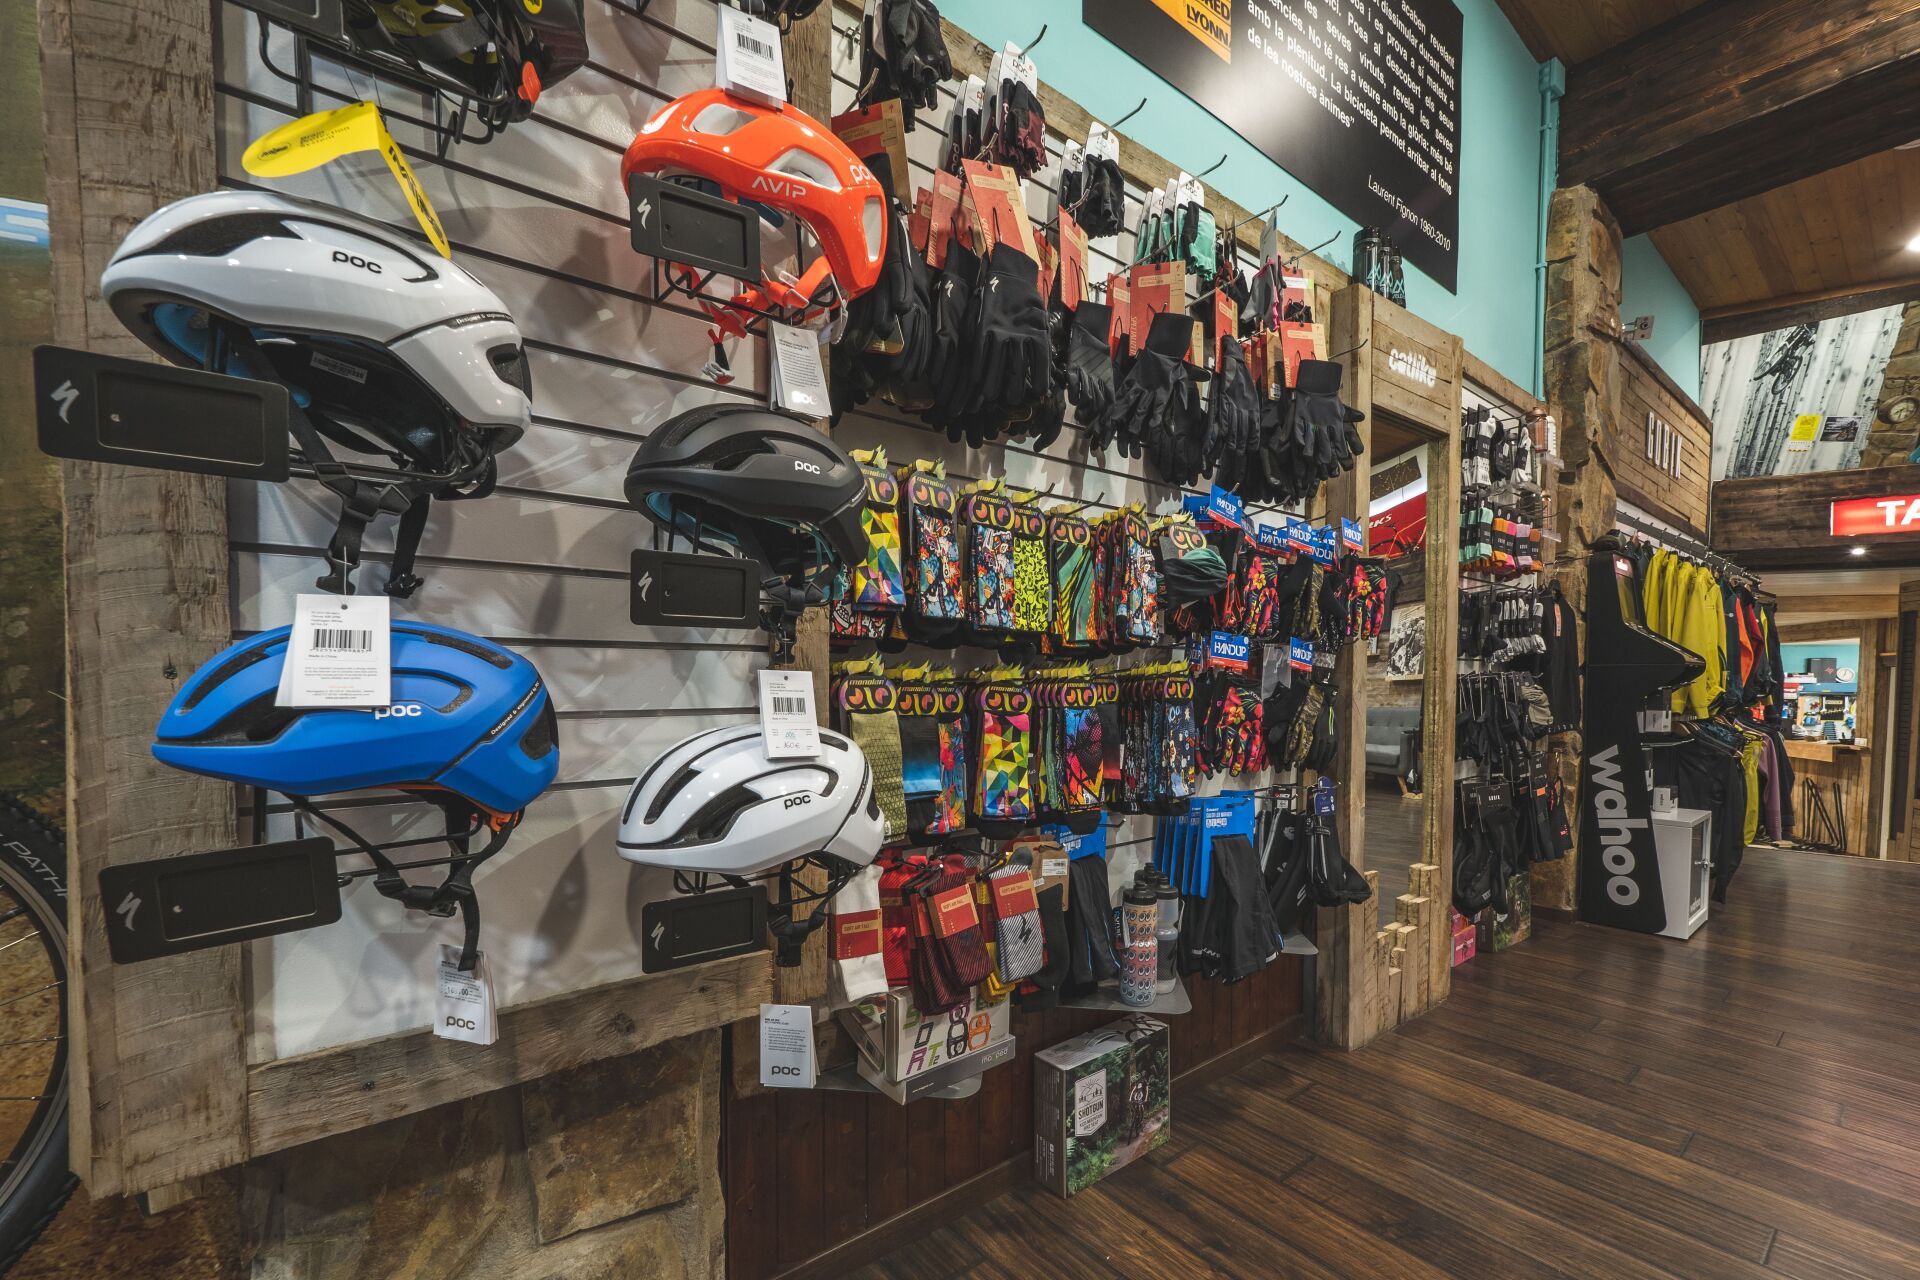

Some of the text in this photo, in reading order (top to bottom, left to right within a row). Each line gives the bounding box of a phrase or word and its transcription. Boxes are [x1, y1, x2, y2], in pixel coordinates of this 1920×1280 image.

[1247, 27, 1262, 49] de
[1264, 38, 1279, 65] les
[1281, 58, 1318, 99] nostres
[1348, 12, 1369, 44] Posa
[1373, 41, 1381, 56] al
[1386, 52, 1421, 98] descobert
[1425, 95, 1435, 113] els
[1438, 109, 1454, 131] seus
[1374, 19, 1383, 35] es
[1387, 32, 1407, 61] prova
[1410, 56, 1415, 69] a
[1426, 74, 1448, 105] mateix
[1449, 99, 1454, 111] a
[1380, 0, 1454, 90] dissimular durant molt
[1401, 2, 1454, 69] acaben revelant
[1247, 0, 1452, 196] amb la plenitud. La bicicleta permet arribar al fons
[1308, 25, 1321, 49] No
[1324, 40, 1333, 60] té
[1335, 55, 1349, 75] res
[1351, 69, 1356, 82] a
[1358, 75, 1381, 105] veure
[1382, 98, 1398, 121] amb
[1400, 113, 1407, 130] la
[1408, 123, 1429, 151] glòria:
[1430, 144, 1444, 166] més
[1444, 156, 1453, 175] bé
[1326, 19, 1351, 52] seves
[1359, 51, 1387, 88] virtuts,
[1393, 85, 1415, 114] revela
[1419, 110, 1430, 130] les
[1435, 128, 1453, 153] seves
[1368, 174, 1451, 252] Laurent Fignon 1960-2010
[1389, 348, 1437, 388] catlike
[1646, 411, 1683, 480] GOBIK
[1343, 527, 1361, 541] HANDUP
[1214, 642, 1246, 656] HANDUP
[1292, 646, 1312, 660] HANDUP
[1589, 744, 1648, 906] wahoo
[1078, 1100, 1104, 1120] SHOTGUN
